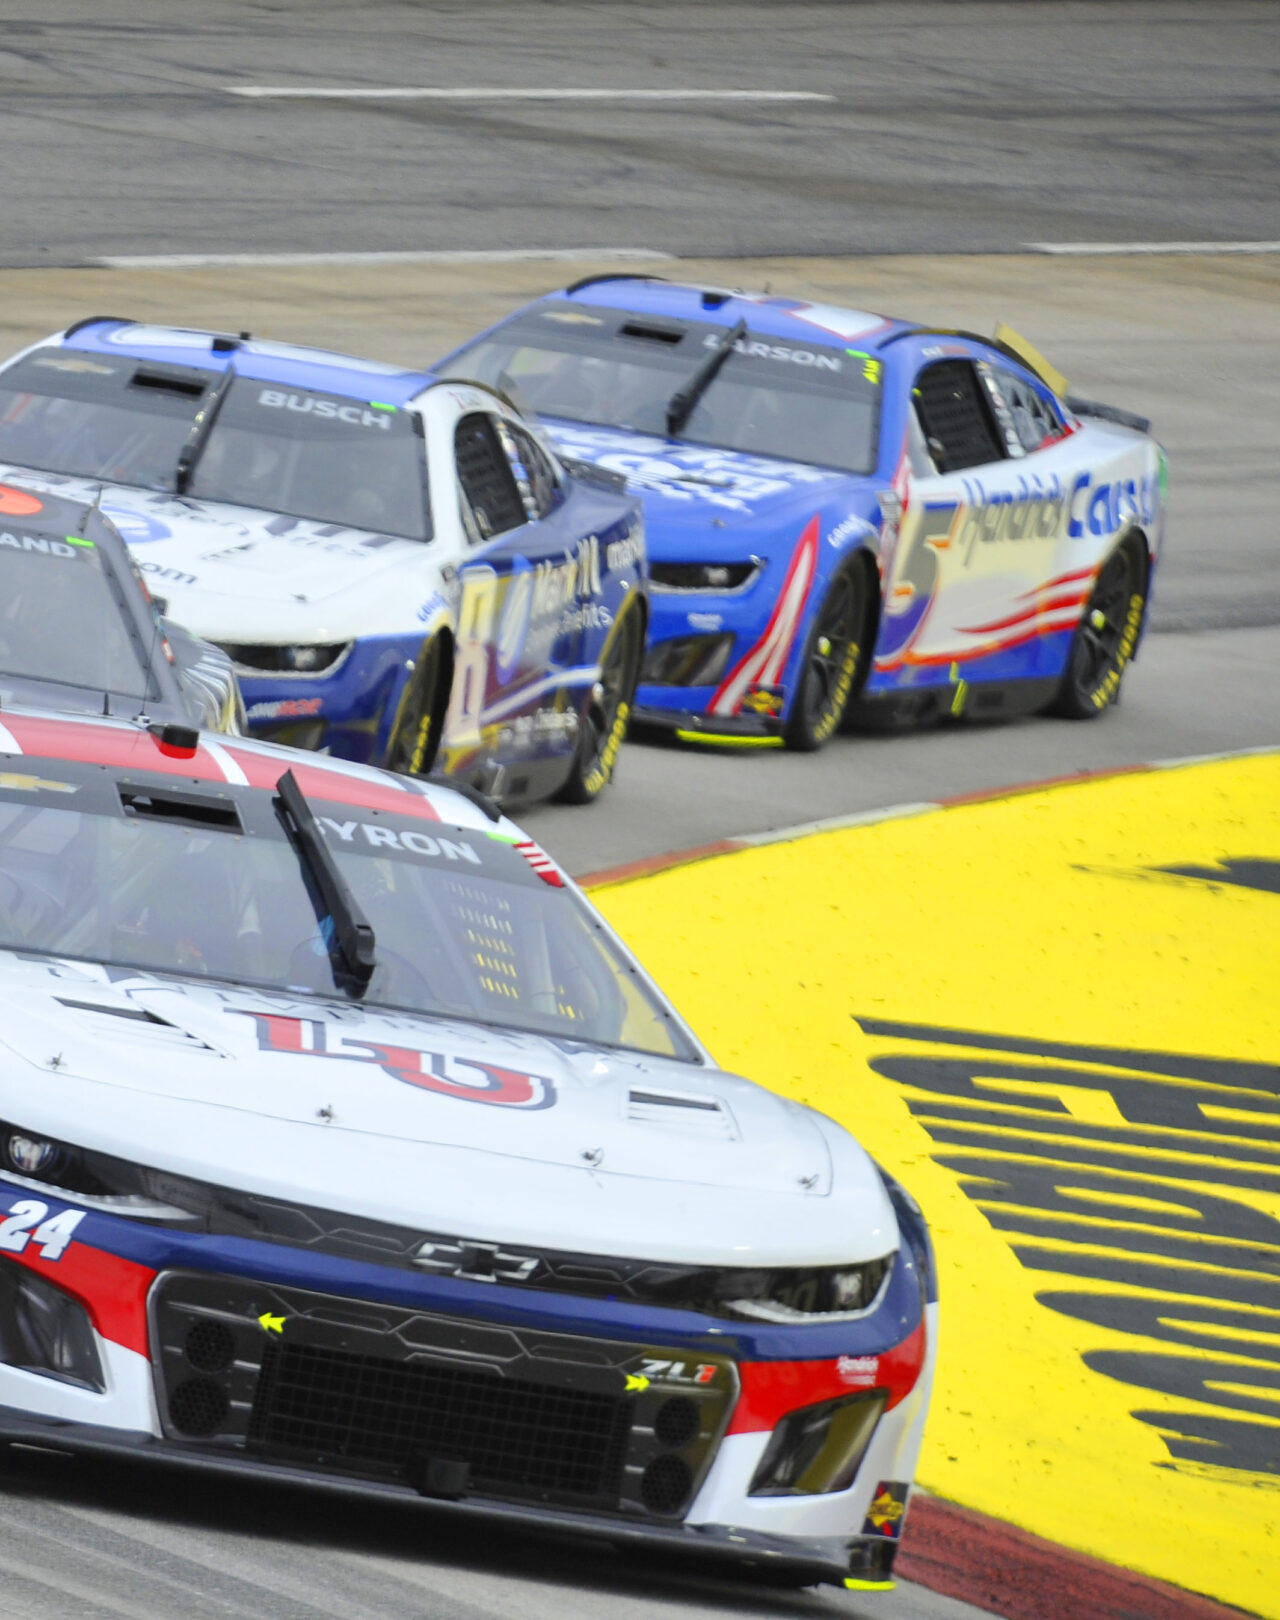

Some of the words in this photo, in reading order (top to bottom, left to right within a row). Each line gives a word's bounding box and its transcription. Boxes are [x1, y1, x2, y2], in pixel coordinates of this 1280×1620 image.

[258, 389, 391, 429] BUSCH
[449, 562, 498, 748] 8
[313, 815, 482, 864] YRON
[632, 1357, 718, 1384] ZL1
